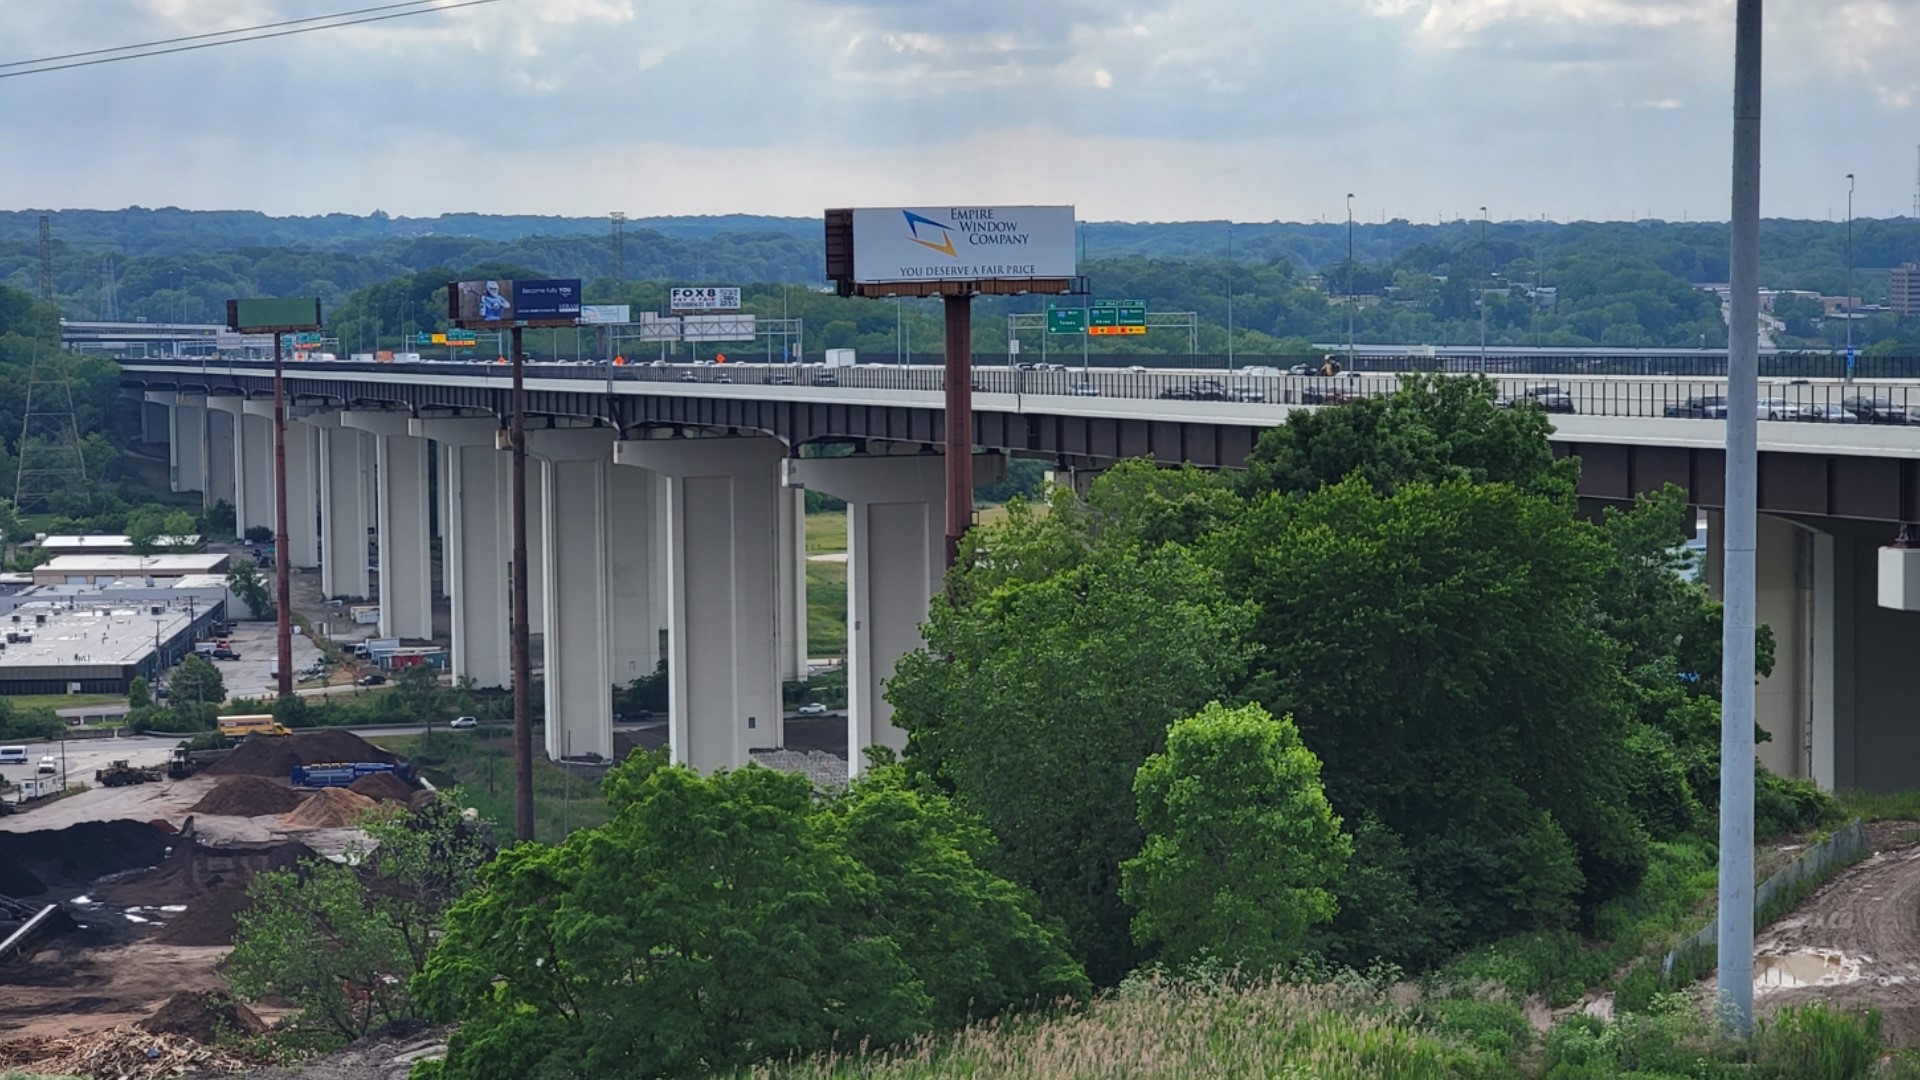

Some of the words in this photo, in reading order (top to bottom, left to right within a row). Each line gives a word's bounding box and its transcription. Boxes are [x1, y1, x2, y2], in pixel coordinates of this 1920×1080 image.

[951, 208, 995, 220] EMPIRE
[959, 220, 1018, 232] WINDOW
[969, 233, 1029, 245] COMPANY
[900, 267, 923, 277] YOU
[926, 265, 970, 276] DESERVE
[972, 265, 979, 275] A
[981, 264, 1005, 275] FAIR
[1006, 264, 1037, 274] PRICE
